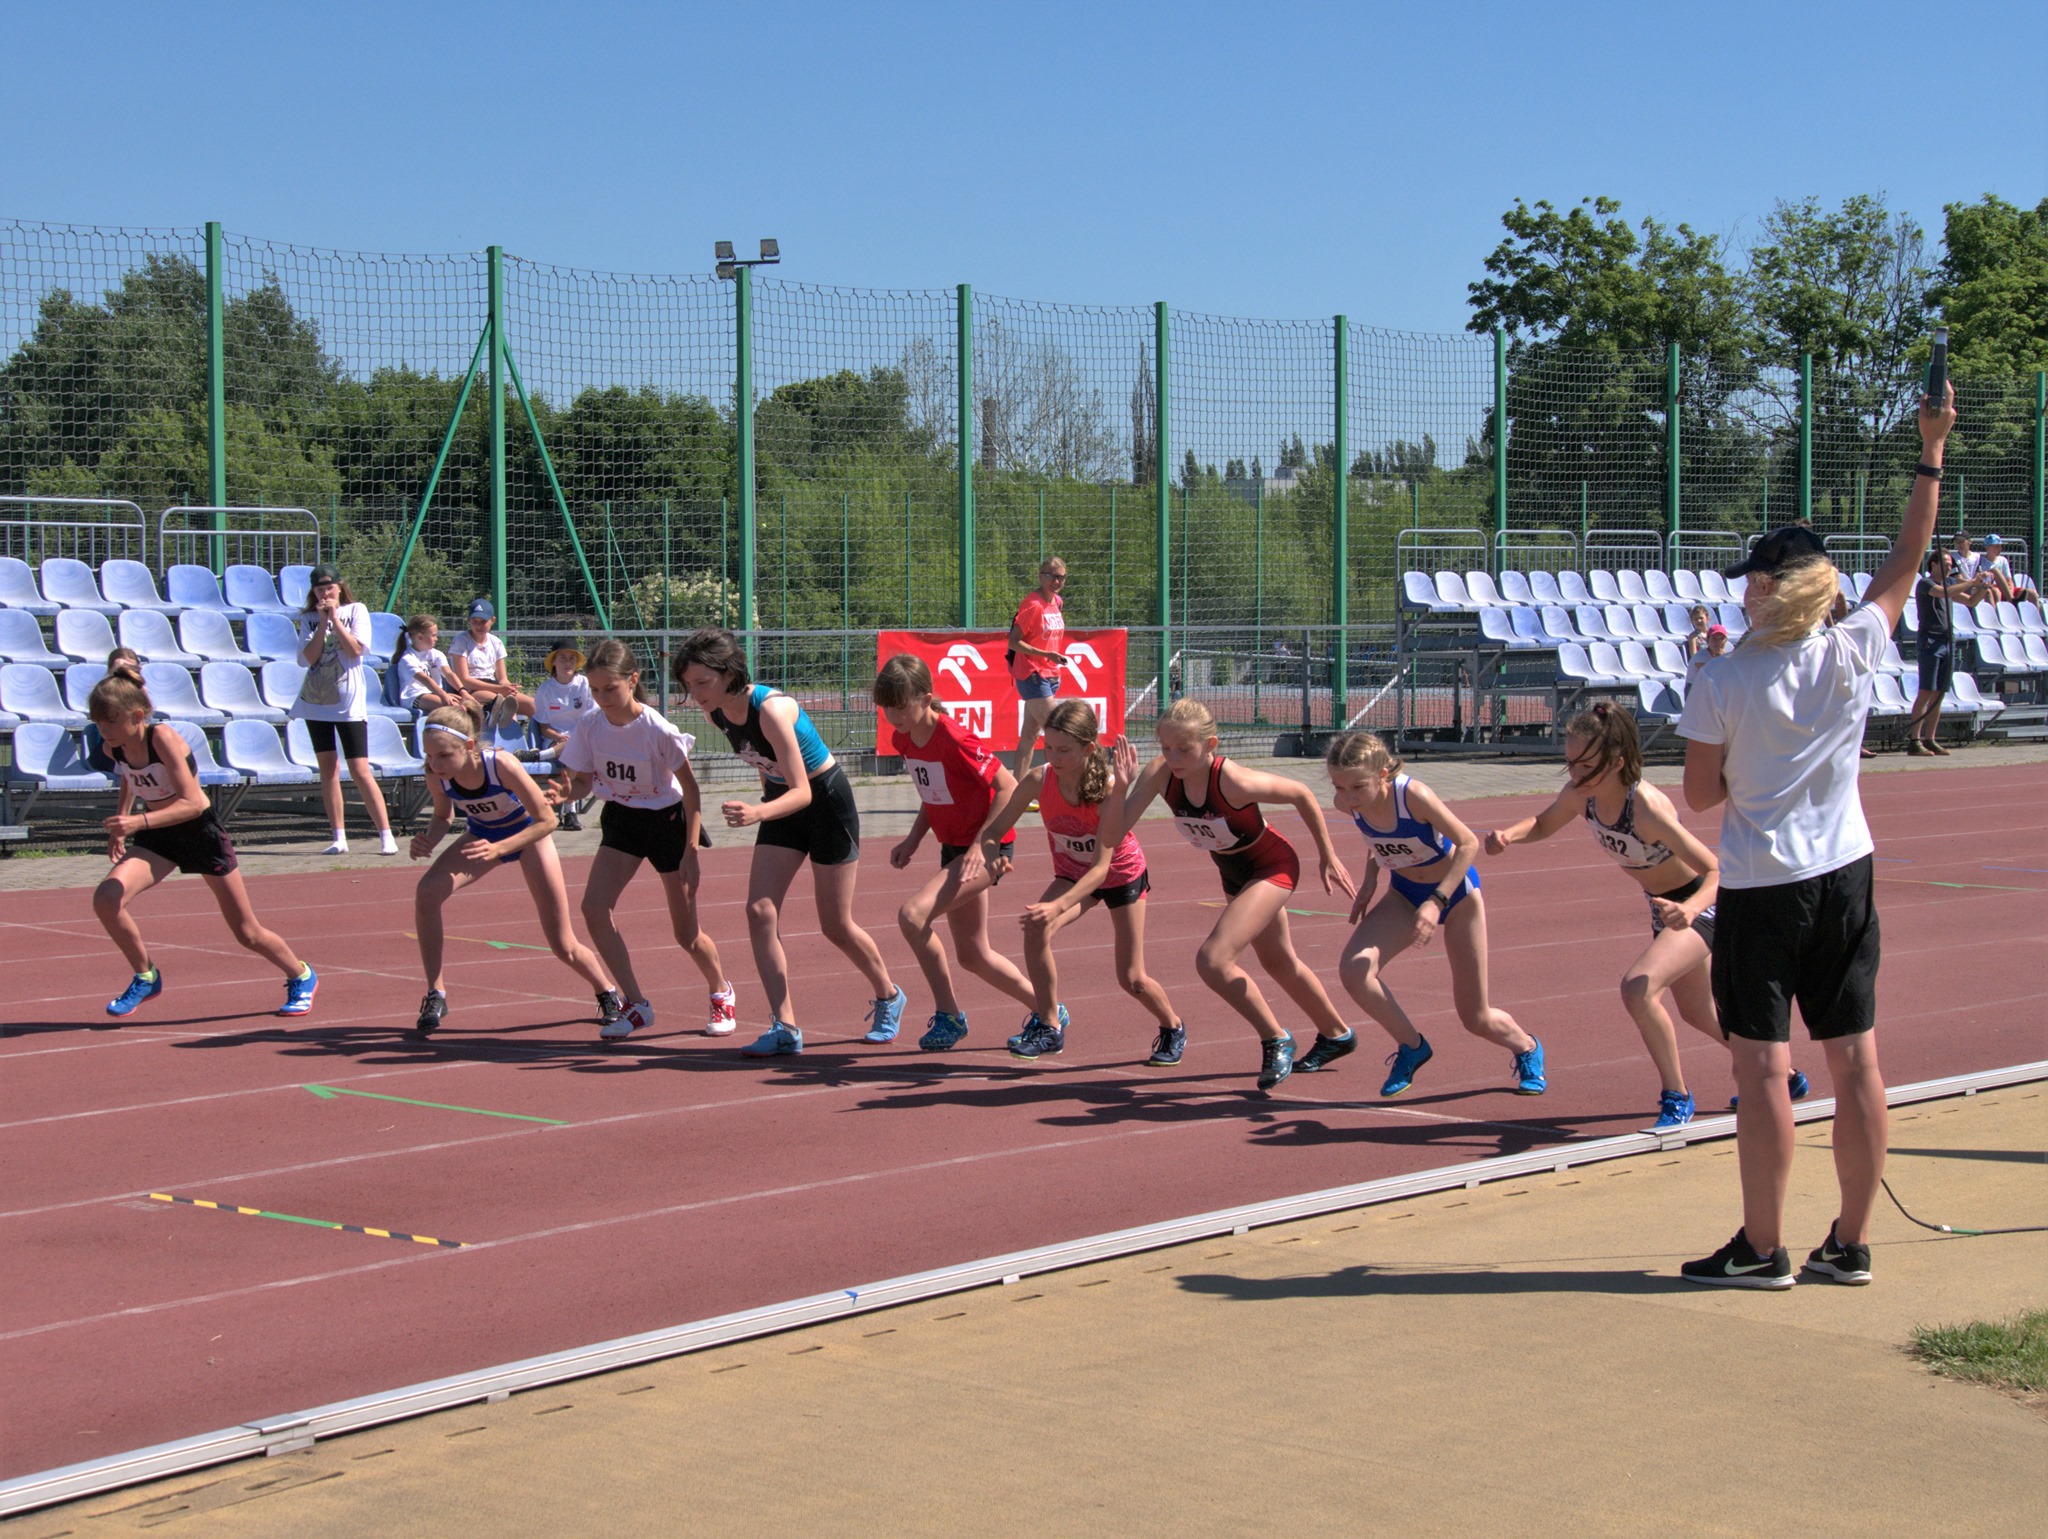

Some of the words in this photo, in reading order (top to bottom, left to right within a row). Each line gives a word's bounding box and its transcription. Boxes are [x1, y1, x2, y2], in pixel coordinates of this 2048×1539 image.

[953, 706, 986, 733] EN
[130, 773, 159, 787] 241
[606, 761, 636, 782] 814
[915, 767, 929, 787] 13
[466, 801, 498, 815] 867
[1374, 843, 1414, 857] 866
